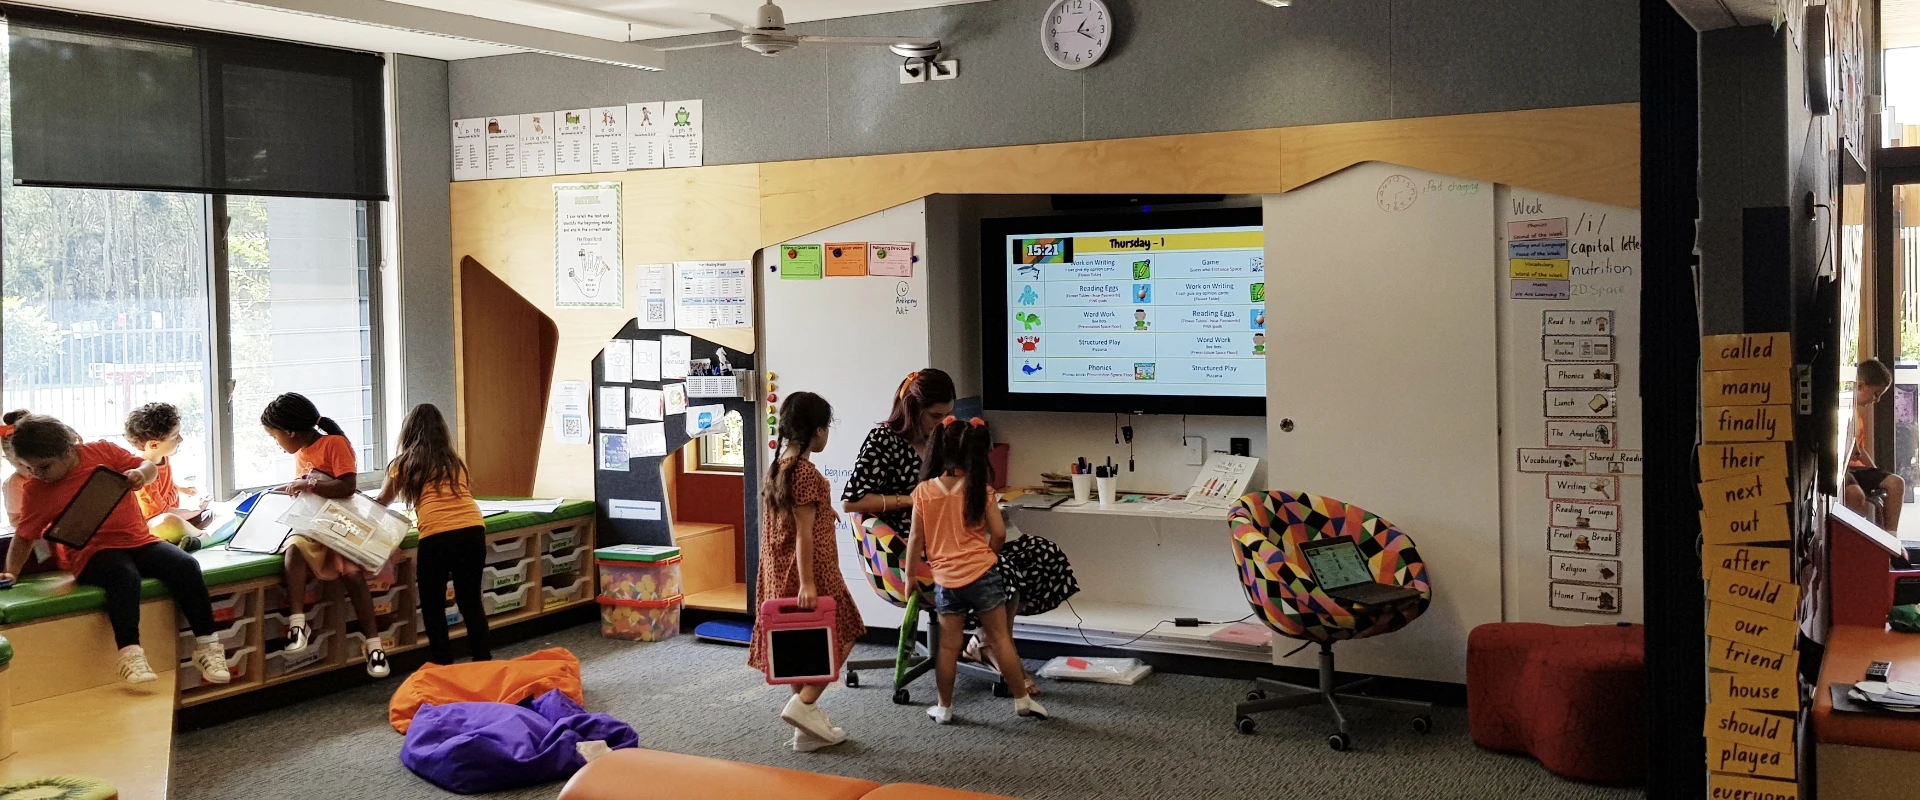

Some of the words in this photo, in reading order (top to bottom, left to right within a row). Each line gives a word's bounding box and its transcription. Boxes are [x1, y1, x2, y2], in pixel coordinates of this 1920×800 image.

[1061, 5, 1069, 13] 11
[1073, 0, 1082, 9] 12
[1053, 16, 1062, 24] 10
[1097, 11, 1103, 20] 2
[1051, 29, 1056, 37] 9
[1100, 25, 1105, 33] 3
[1054, 42, 1059, 51] 8
[1097, 38, 1102, 47] 4
[1063, 52, 1068, 60] 7
[1075, 54, 1080, 62] 6
[1088, 50, 1093, 58] 5
[1513, 198, 1544, 215] Week
[1027, 243, 1059, 256] 15:21
[1109, 237, 1151, 250] Thursday
[1571, 237, 1614, 257] capital
[1571, 257, 1632, 275] nutrition
[1104, 284, 1119, 292] Eggs
[895, 296, 918, 307] Anthony
[1547, 317, 1564, 325] Read
[1569, 317, 1576, 325] to
[1581, 317, 1592, 325] self
[1553, 339, 1575, 348] Morning
[1721, 336, 1773, 359] called
[1558, 370, 1585, 379] Phonics
[1722, 382, 1771, 403] many
[1554, 398, 1575, 406] Lunch
[1718, 408, 1776, 440] finally
[1551, 429, 1563, 437] The
[1569, 429, 1594, 440] Angelus
[1523, 455, 1562, 467] Vocabulary
[1589, 452, 1614, 461] Shared
[1721, 447, 1764, 469] their
[1557, 481, 1586, 493] Writing
[1725, 474, 1763, 502] next
[1555, 504, 1582, 516] Reading
[1588, 506, 1614, 518] Groups
[1730, 510, 1759, 532] out
[1553, 529, 1572, 538] Fruit
[1591, 532, 1613, 542] Break
[1722, 549, 1770, 571] after
[1560, 563, 1587, 575] Religion
[1554, 591, 1574, 600] Home
[1581, 592, 1598, 601] Time
[1729, 581, 1781, 604] could
[1735, 620, 1768, 636] our
[1726, 641, 1785, 670] friend
[1729, 676, 1780, 699] house
[1718, 710, 1781, 739] should
[1720, 743, 1780, 773] played
